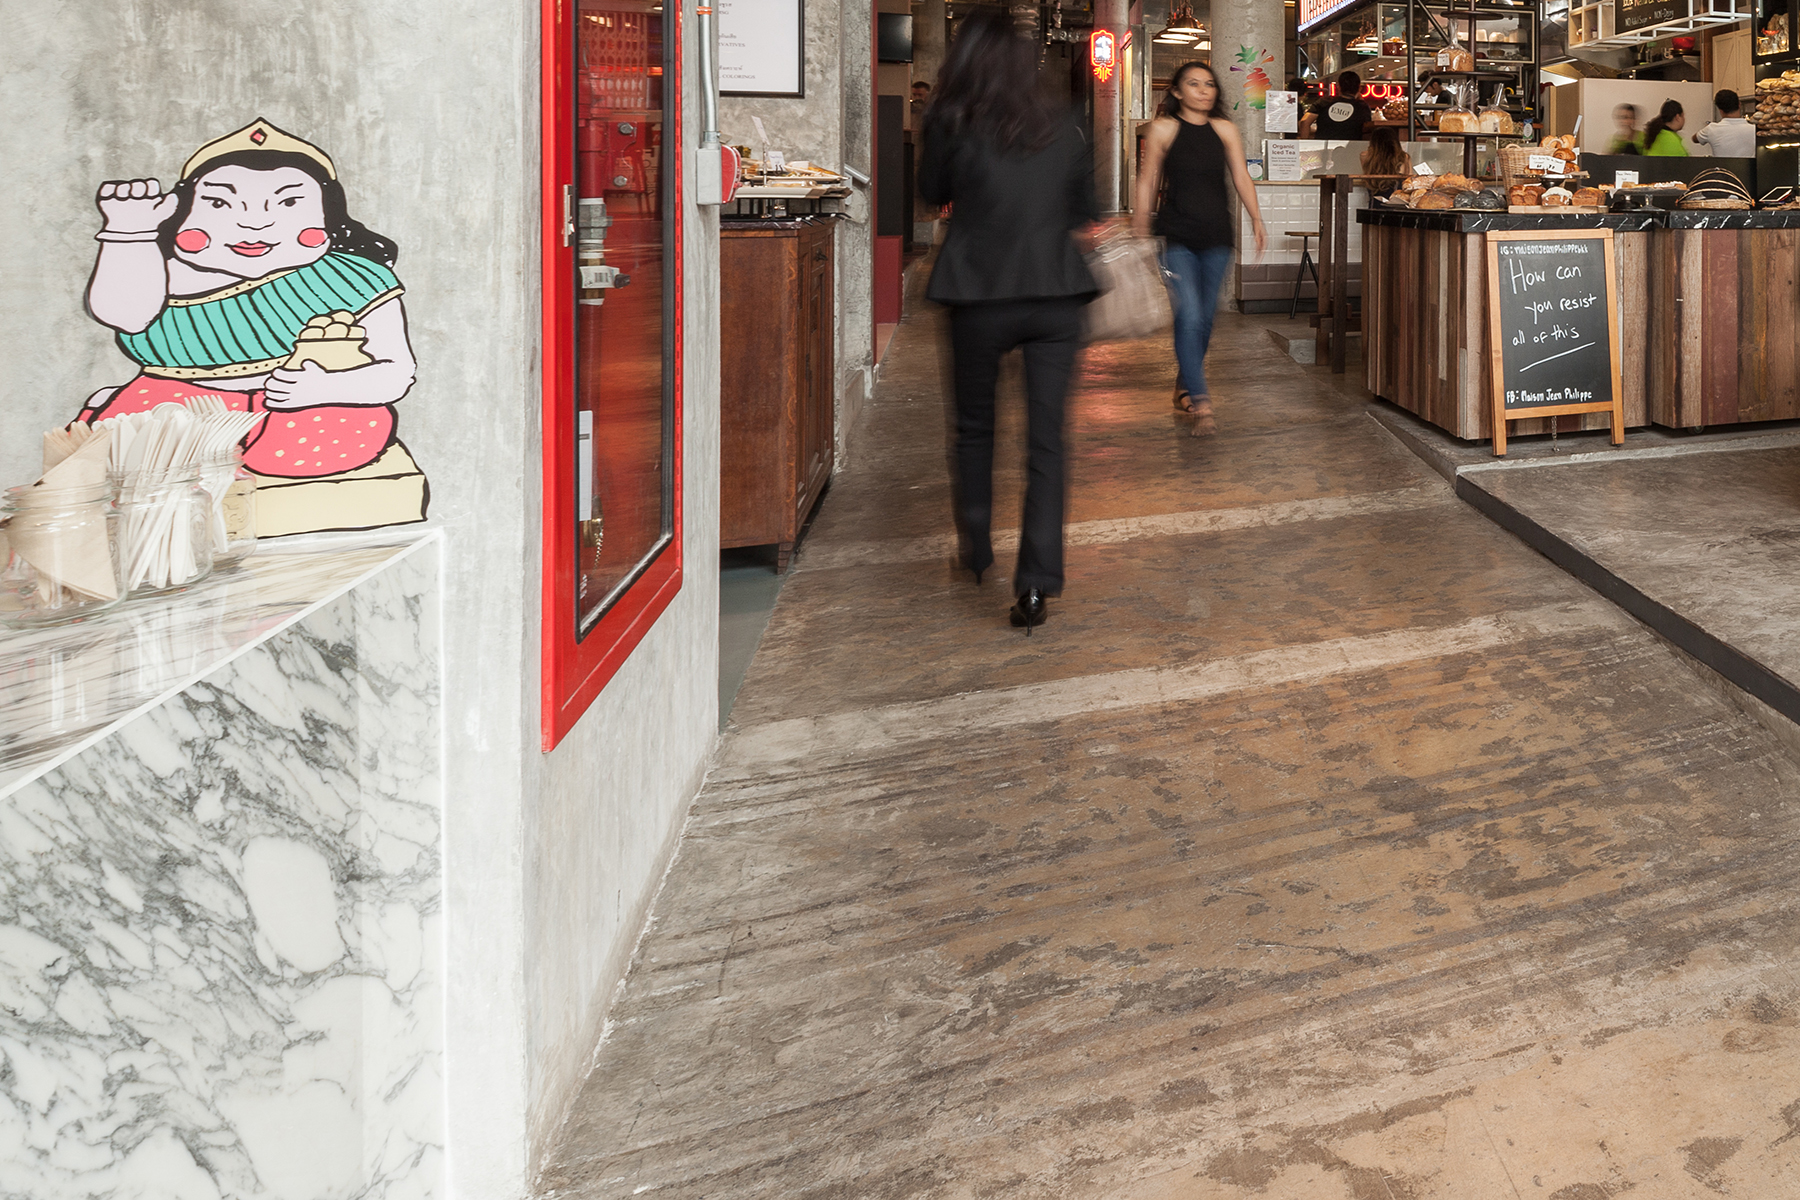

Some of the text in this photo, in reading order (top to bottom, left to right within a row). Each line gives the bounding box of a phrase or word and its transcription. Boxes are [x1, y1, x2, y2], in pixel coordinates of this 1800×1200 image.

[1509, 258, 1582, 294] How can
[1524, 290, 1597, 325] you resist
[1512, 323, 1580, 346] all of this
[1521, 390, 1545, 402] Maison
[1546, 388, 1562, 402] Jean
[1564, 387, 1593, 402] Philippe
